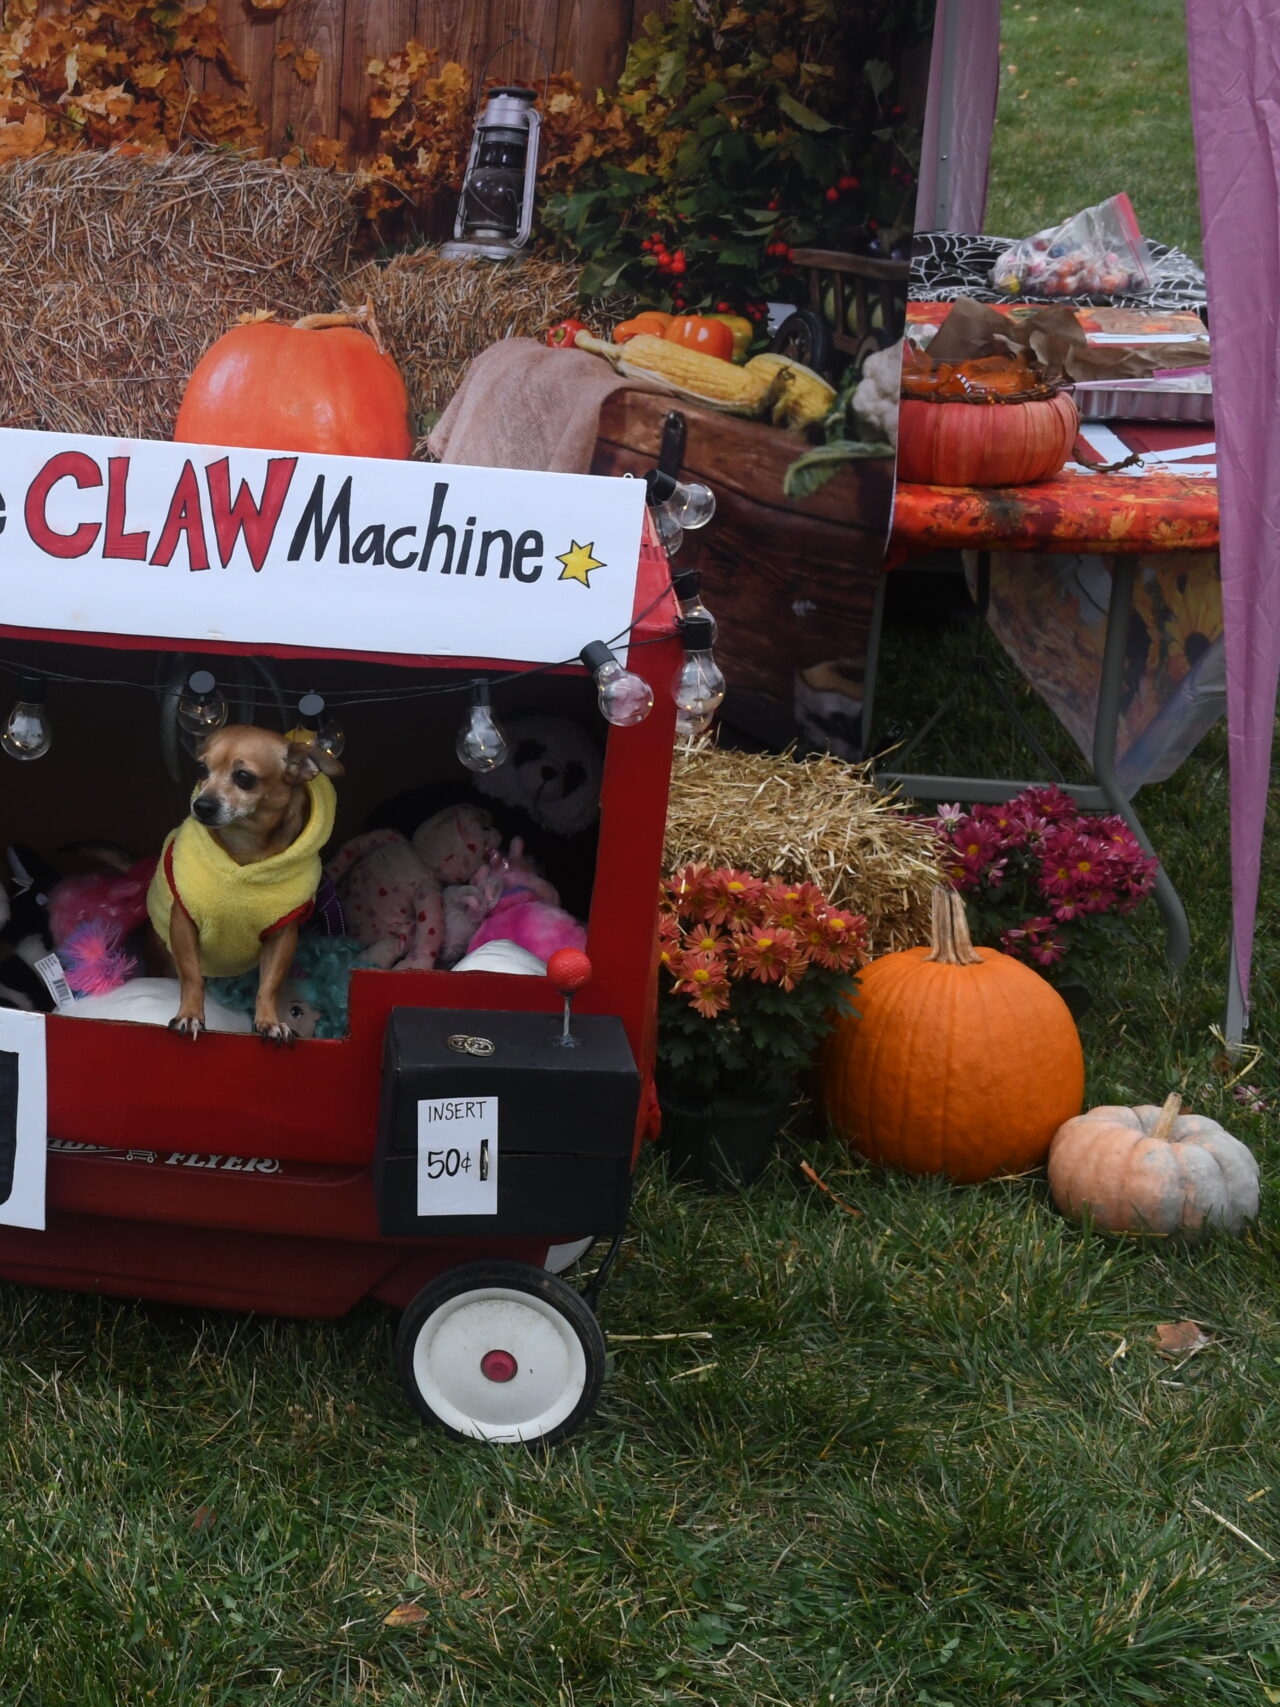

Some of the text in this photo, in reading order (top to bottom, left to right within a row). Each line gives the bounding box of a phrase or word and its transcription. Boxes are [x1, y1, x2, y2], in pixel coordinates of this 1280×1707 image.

[24, 450, 299, 573] CLAW
[287, 474, 544, 584] Machine
[427, 1101, 487, 1123] INSERT
[426, 1148, 472, 1179] 50¢
